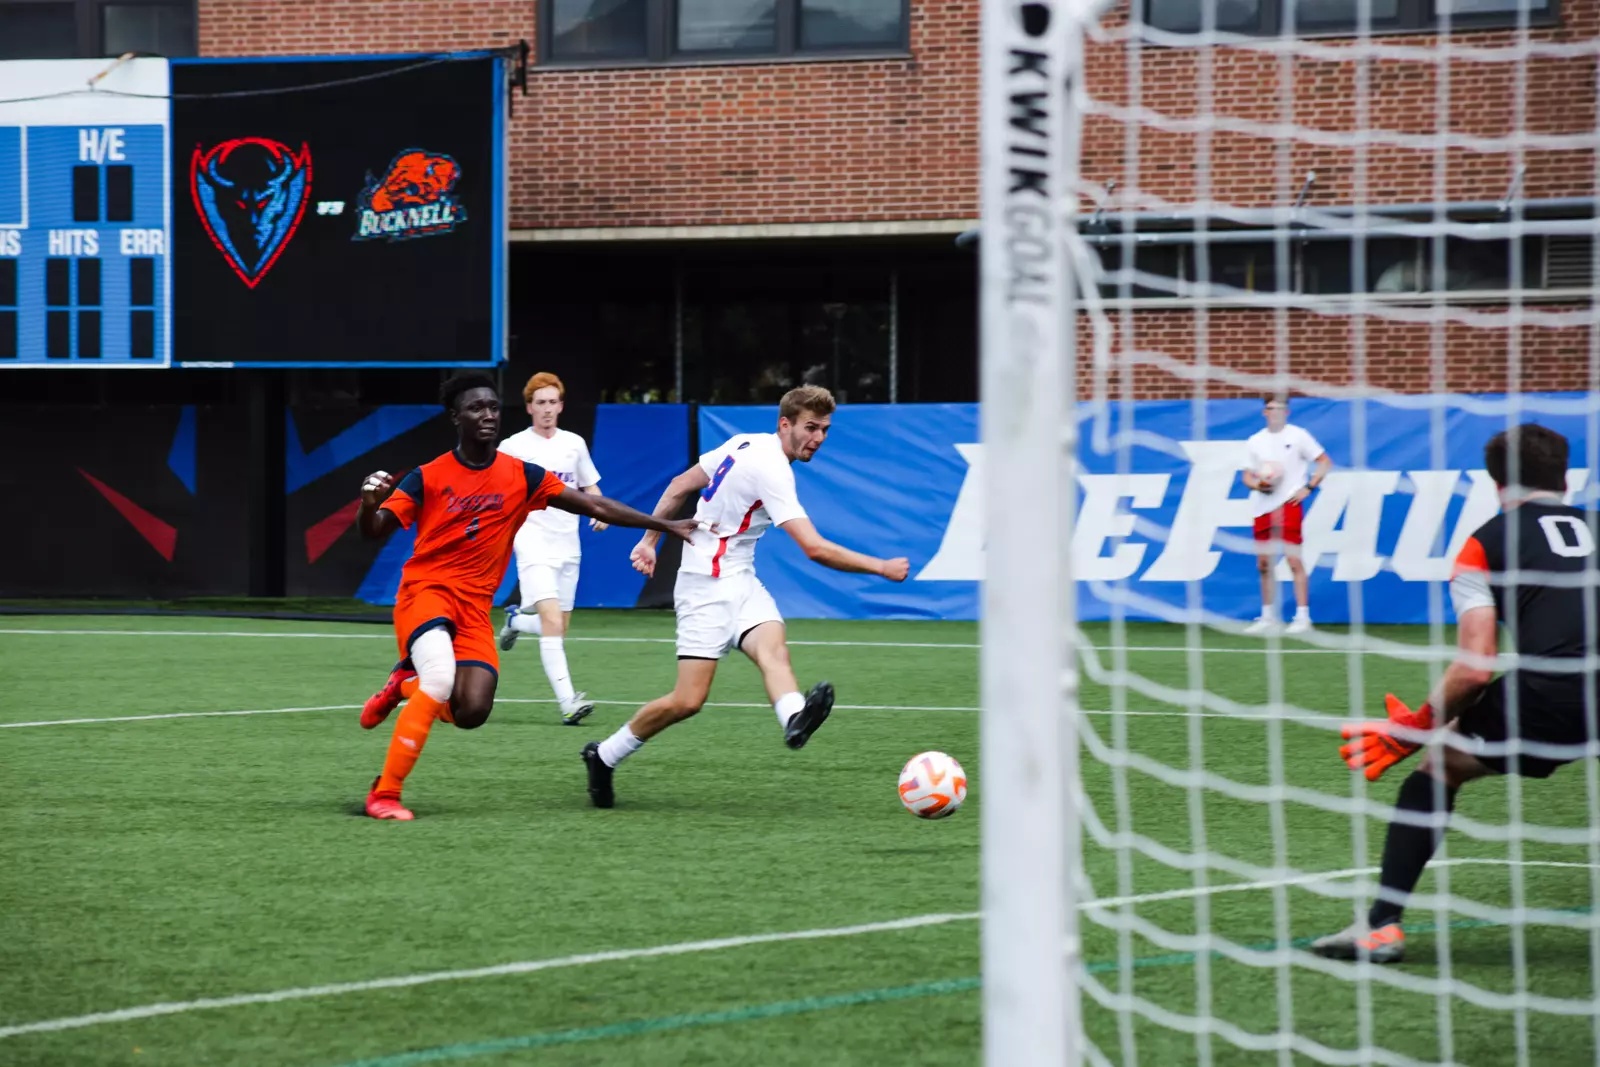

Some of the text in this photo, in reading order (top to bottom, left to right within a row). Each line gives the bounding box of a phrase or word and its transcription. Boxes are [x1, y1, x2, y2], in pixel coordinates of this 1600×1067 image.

[78, 128, 126, 164] H/E
[360, 202, 455, 236] BUCKNELL
[49, 229, 100, 256] HITS
[120, 229, 164, 255] ERR
[701, 454, 736, 502] 9
[1538, 515, 1595, 558] 0
